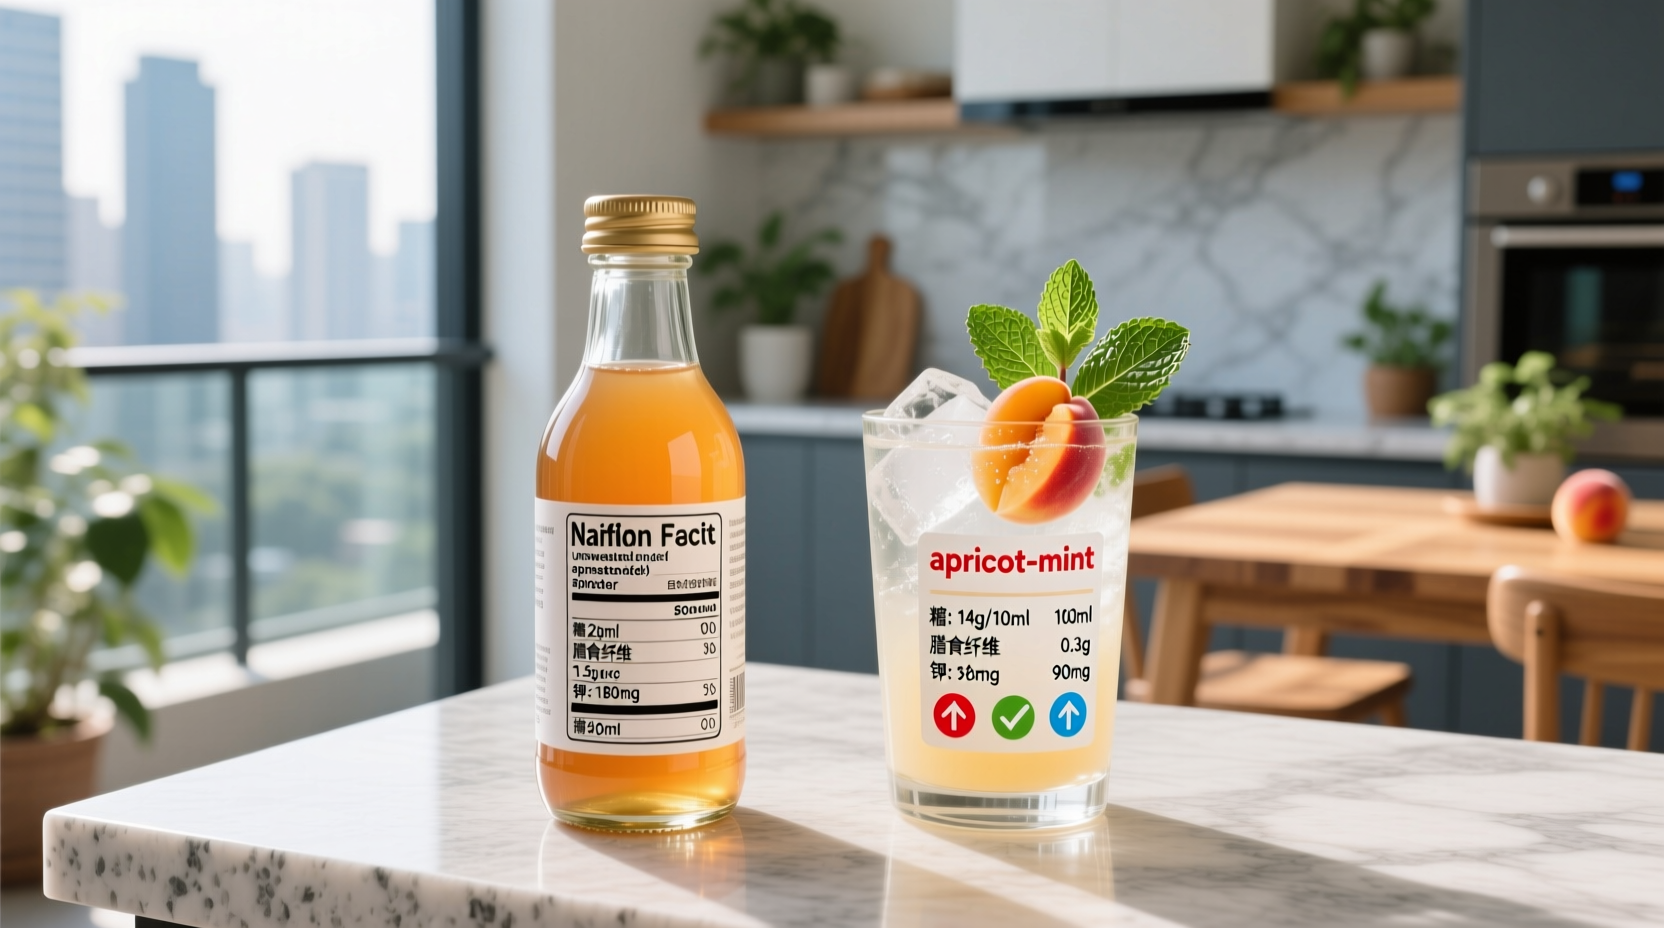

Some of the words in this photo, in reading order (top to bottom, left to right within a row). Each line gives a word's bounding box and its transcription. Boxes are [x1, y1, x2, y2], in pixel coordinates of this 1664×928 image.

[929, 545, 1095, 579] apricot-mint
[957, 608, 1030, 630] 14g/10ml
[1054, 605, 1093, 625] 100ml
[1060, 636, 1091, 656] 0.3g
[1052, 664, 1091, 682] 90mg
